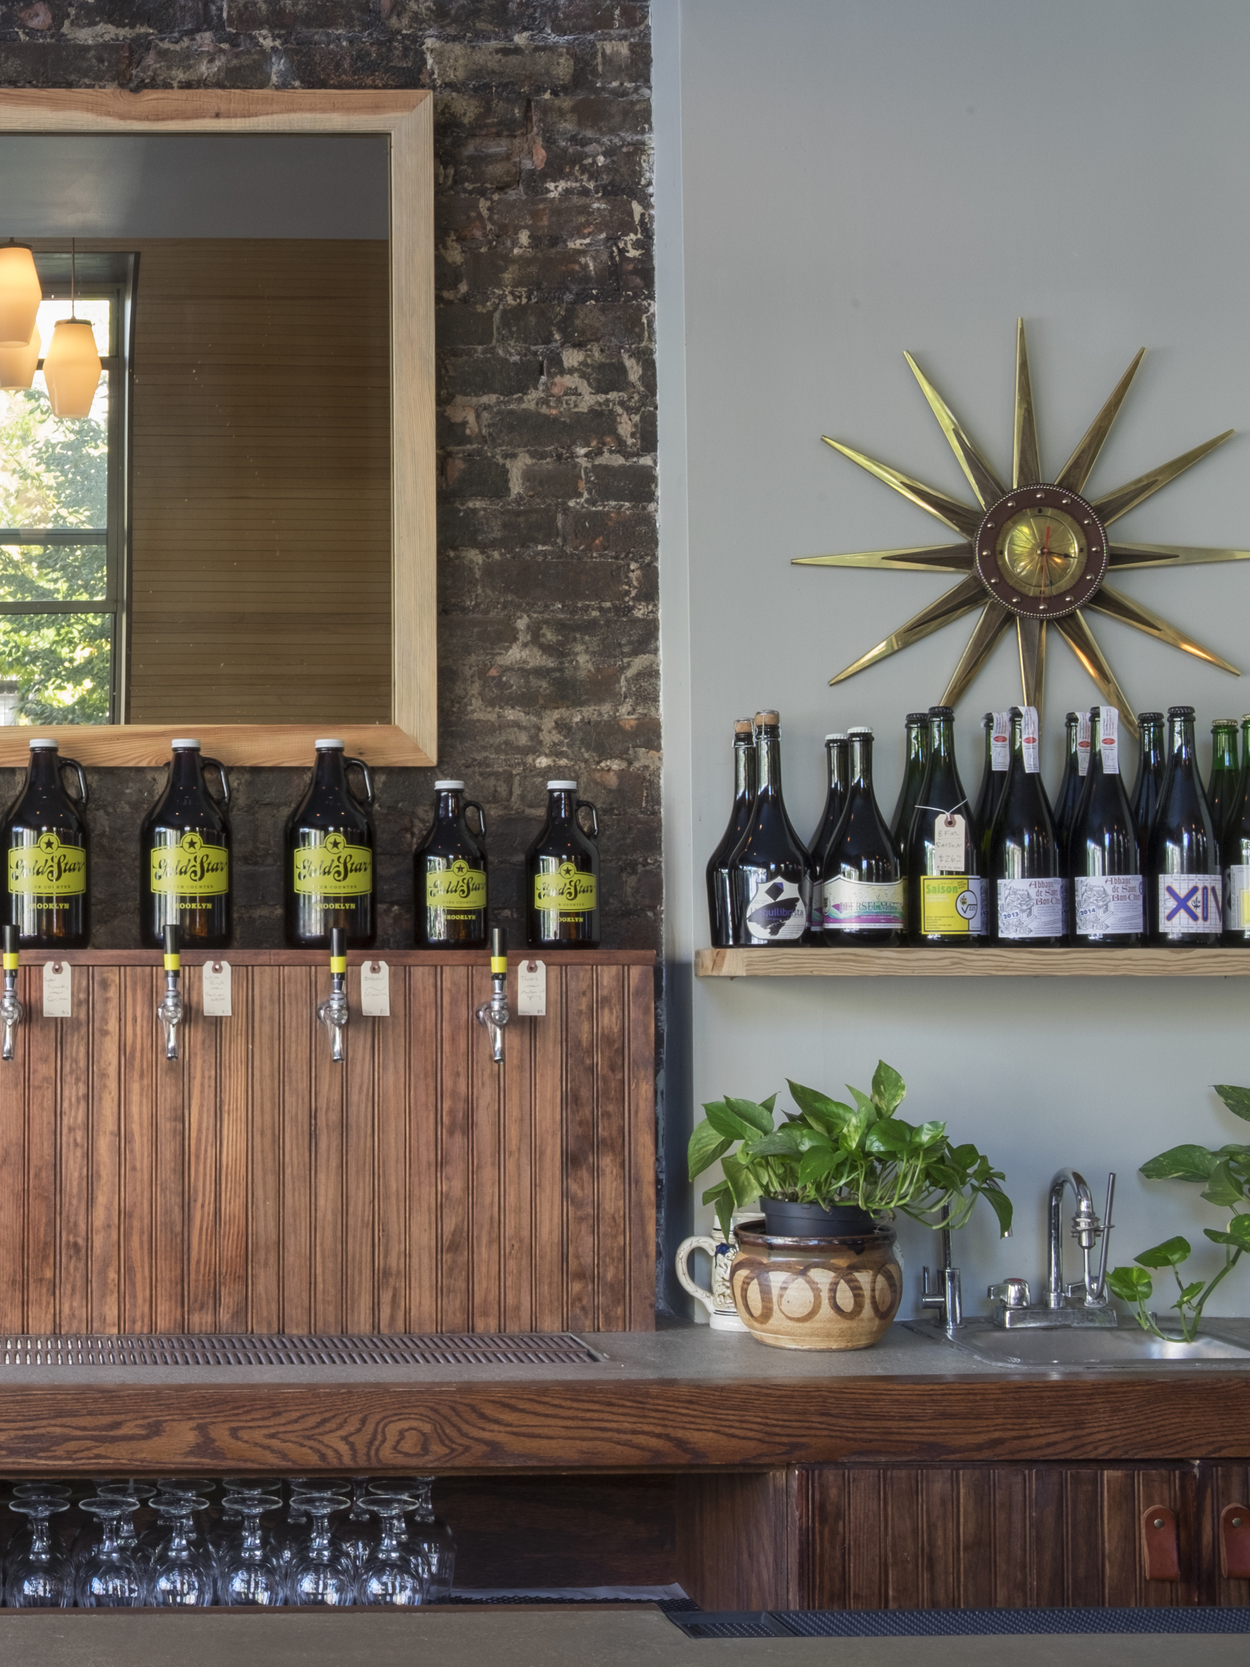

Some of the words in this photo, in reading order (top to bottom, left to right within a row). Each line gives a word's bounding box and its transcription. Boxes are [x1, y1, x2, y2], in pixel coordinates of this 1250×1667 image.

[10, 859, 48, 881] Gld
[47, 854, 85, 882] Star
[153, 859, 191, 881] Gld
[190, 854, 227, 882] Star
[333, 854, 371, 882] Star
[429, 880, 459, 897] Gld
[458, 876, 486, 898] Star
[565, 879, 595, 901] Star
[926, 883, 958, 894] Saison
[1003, 911, 1019, 919] 2013
[1080, 907, 1096, 916] 2014
